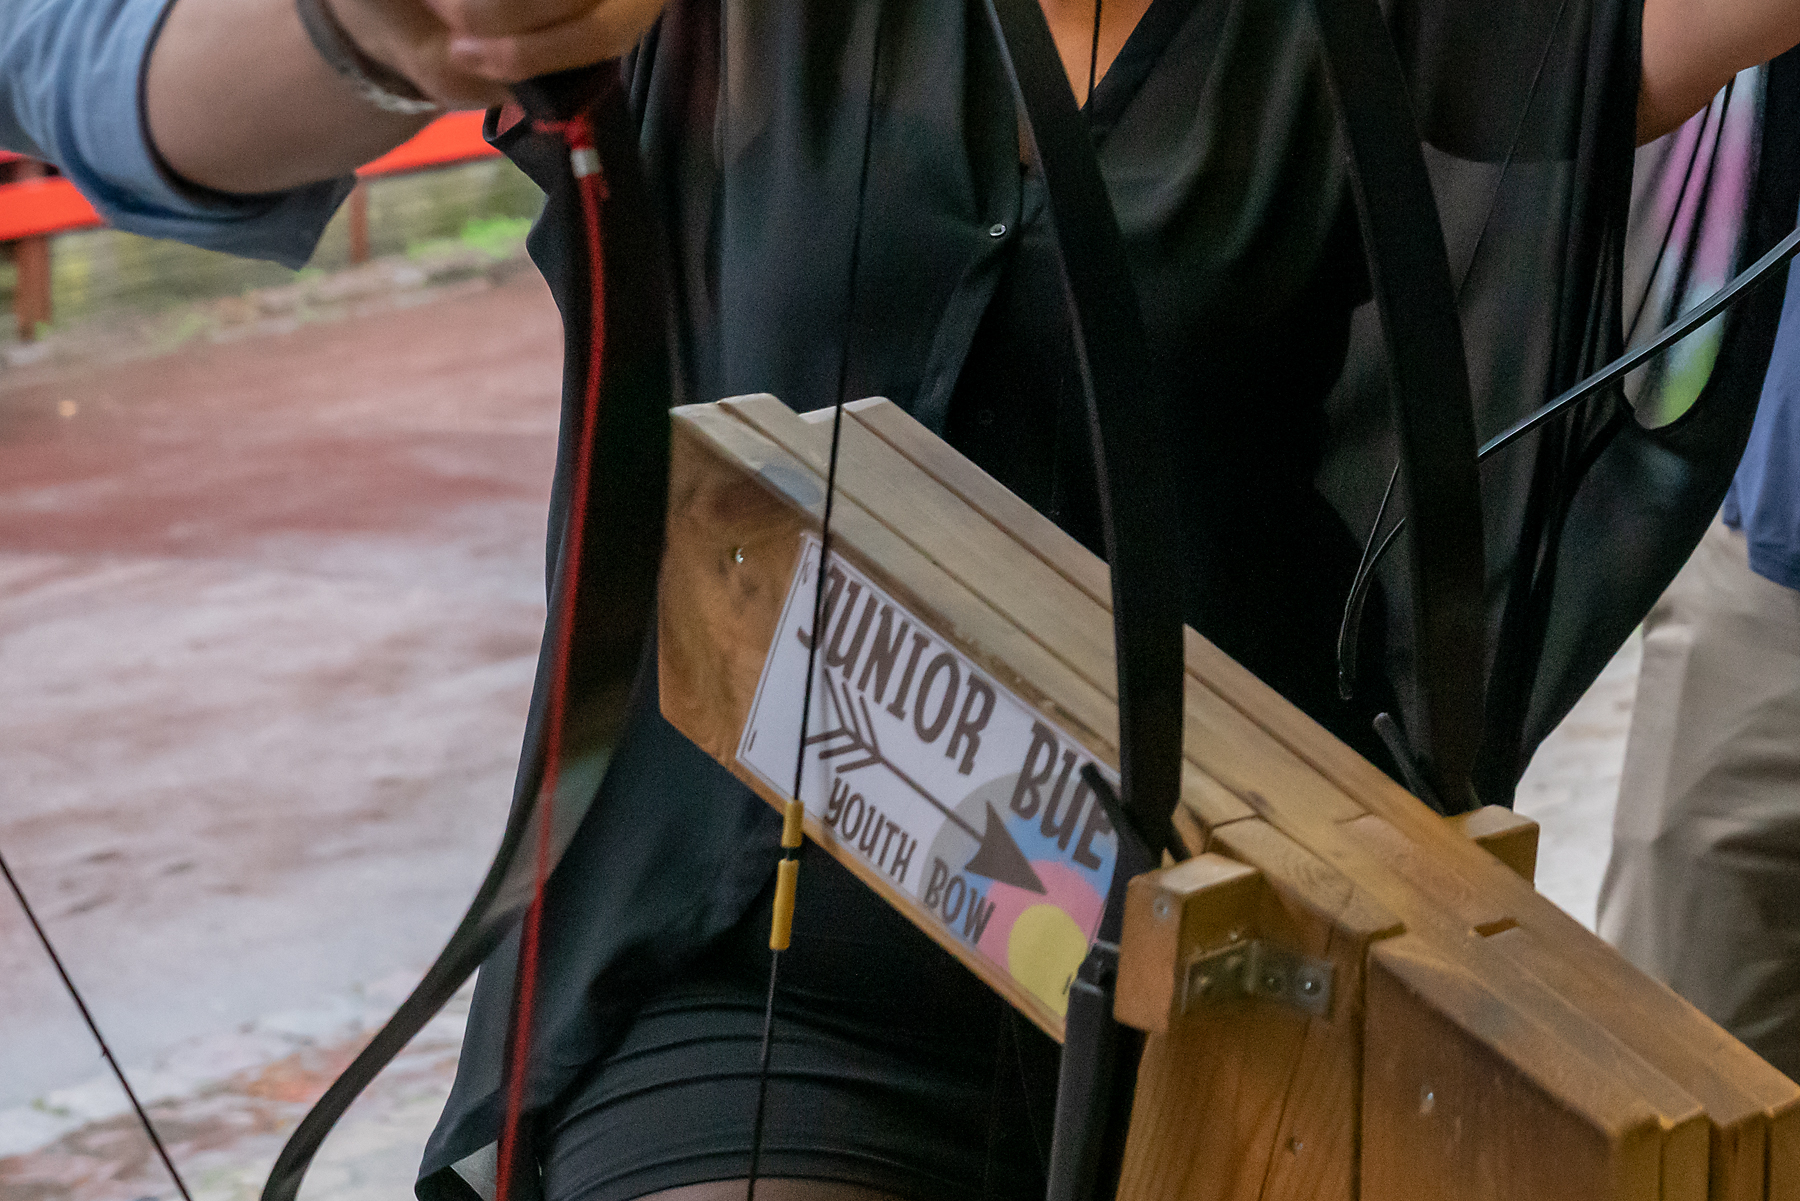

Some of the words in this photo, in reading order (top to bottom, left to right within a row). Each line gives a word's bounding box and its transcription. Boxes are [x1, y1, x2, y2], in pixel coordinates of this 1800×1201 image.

[797, 564, 997, 776] JUNIOR
[1009, 720, 1114, 871] BUE
[824, 777, 918, 883] YOUTH
[923, 856, 998, 945] BOW
